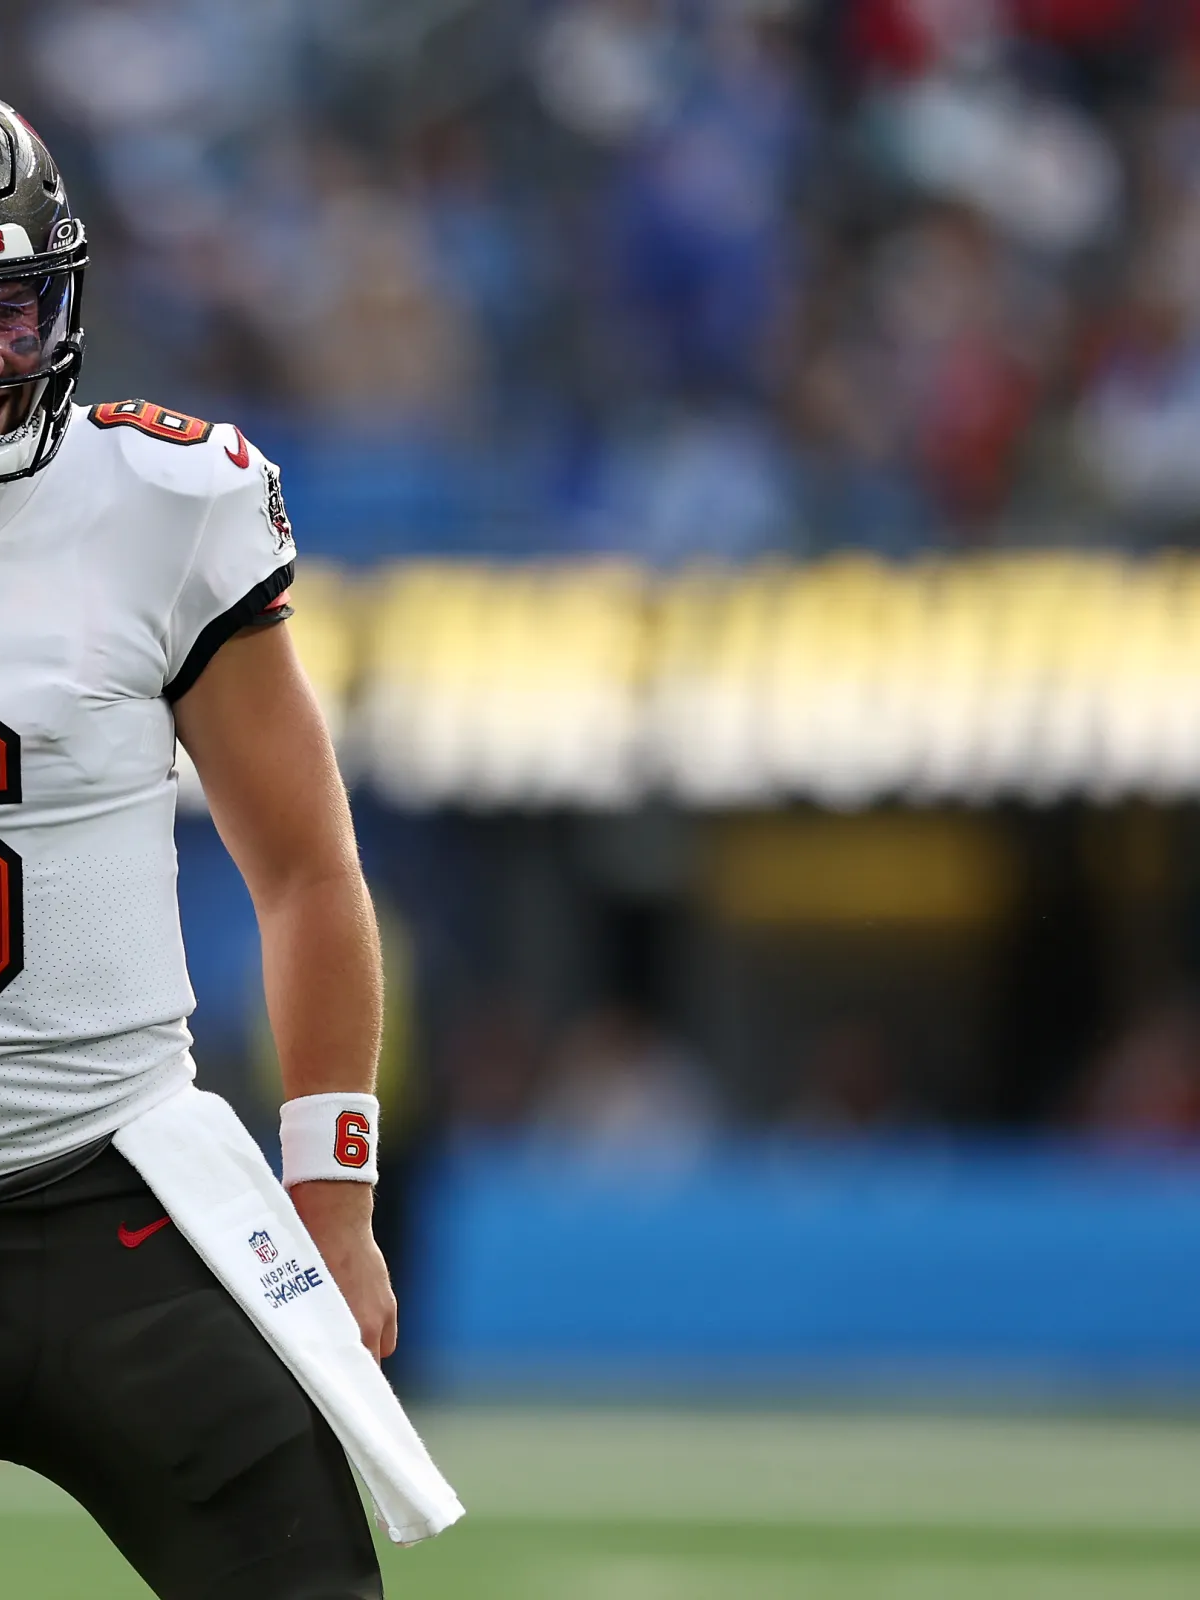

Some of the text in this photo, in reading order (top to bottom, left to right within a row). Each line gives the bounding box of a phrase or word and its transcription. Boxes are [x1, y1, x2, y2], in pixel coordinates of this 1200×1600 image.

[333, 1110, 370, 1169] 6
[255, 1244, 276, 1262] NFL
[259, 1259, 300, 1288] INSPIRE
[263, 1266, 323, 1309] CHANGE
